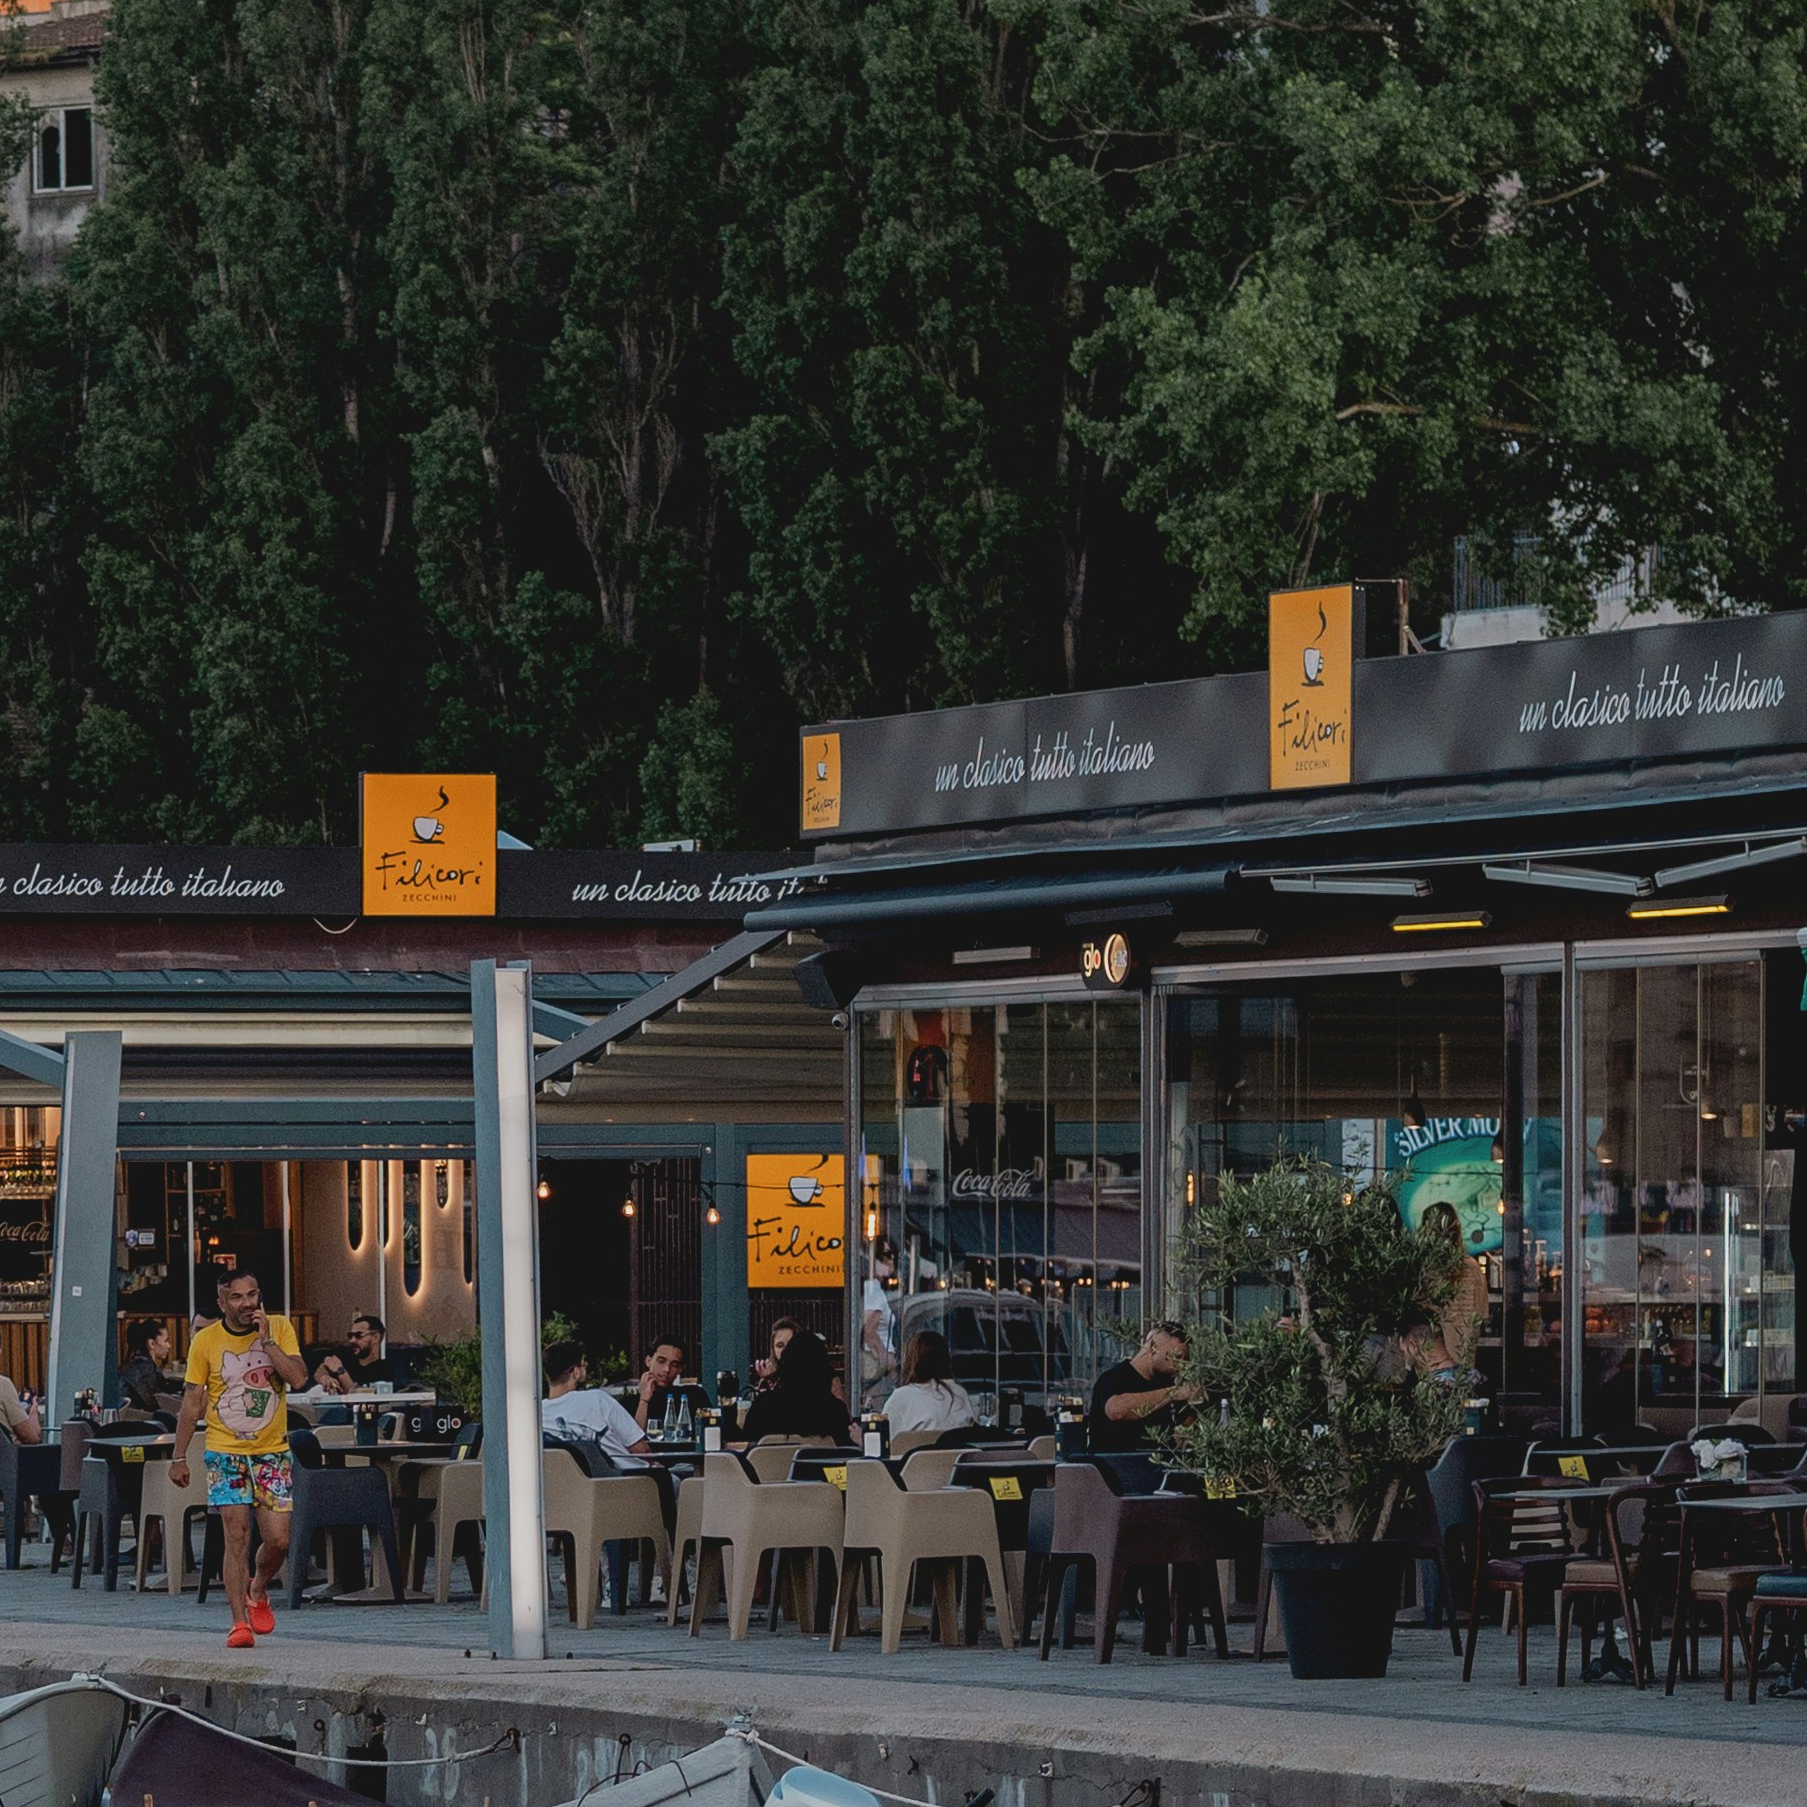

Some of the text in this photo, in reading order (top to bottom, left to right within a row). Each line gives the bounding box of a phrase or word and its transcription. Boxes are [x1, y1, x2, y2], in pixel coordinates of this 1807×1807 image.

[1520, 652, 1785, 732] un clasico tutto italiano
[1278, 699, 1347, 757] Filicori
[935, 720, 1155, 792] un clasico tutto italiano
[1295, 760, 1330, 771] ZECCHINI
[13, 863, 103, 895] clasico
[110, 866, 175, 896] tutto
[182, 865, 285, 897] italiano
[375, 851, 482, 890] Filicori
[572, 884, 609, 901] un
[615, 870, 702, 902] clasico
[402, 894, 456, 902] ZECCHINI
[1082, 943, 1101, 977] glo
[747, 1216, 842, 1262] Filico
[779, 1265, 840, 1274] ZECCHINI
[437, 1414, 461, 1434] glo
